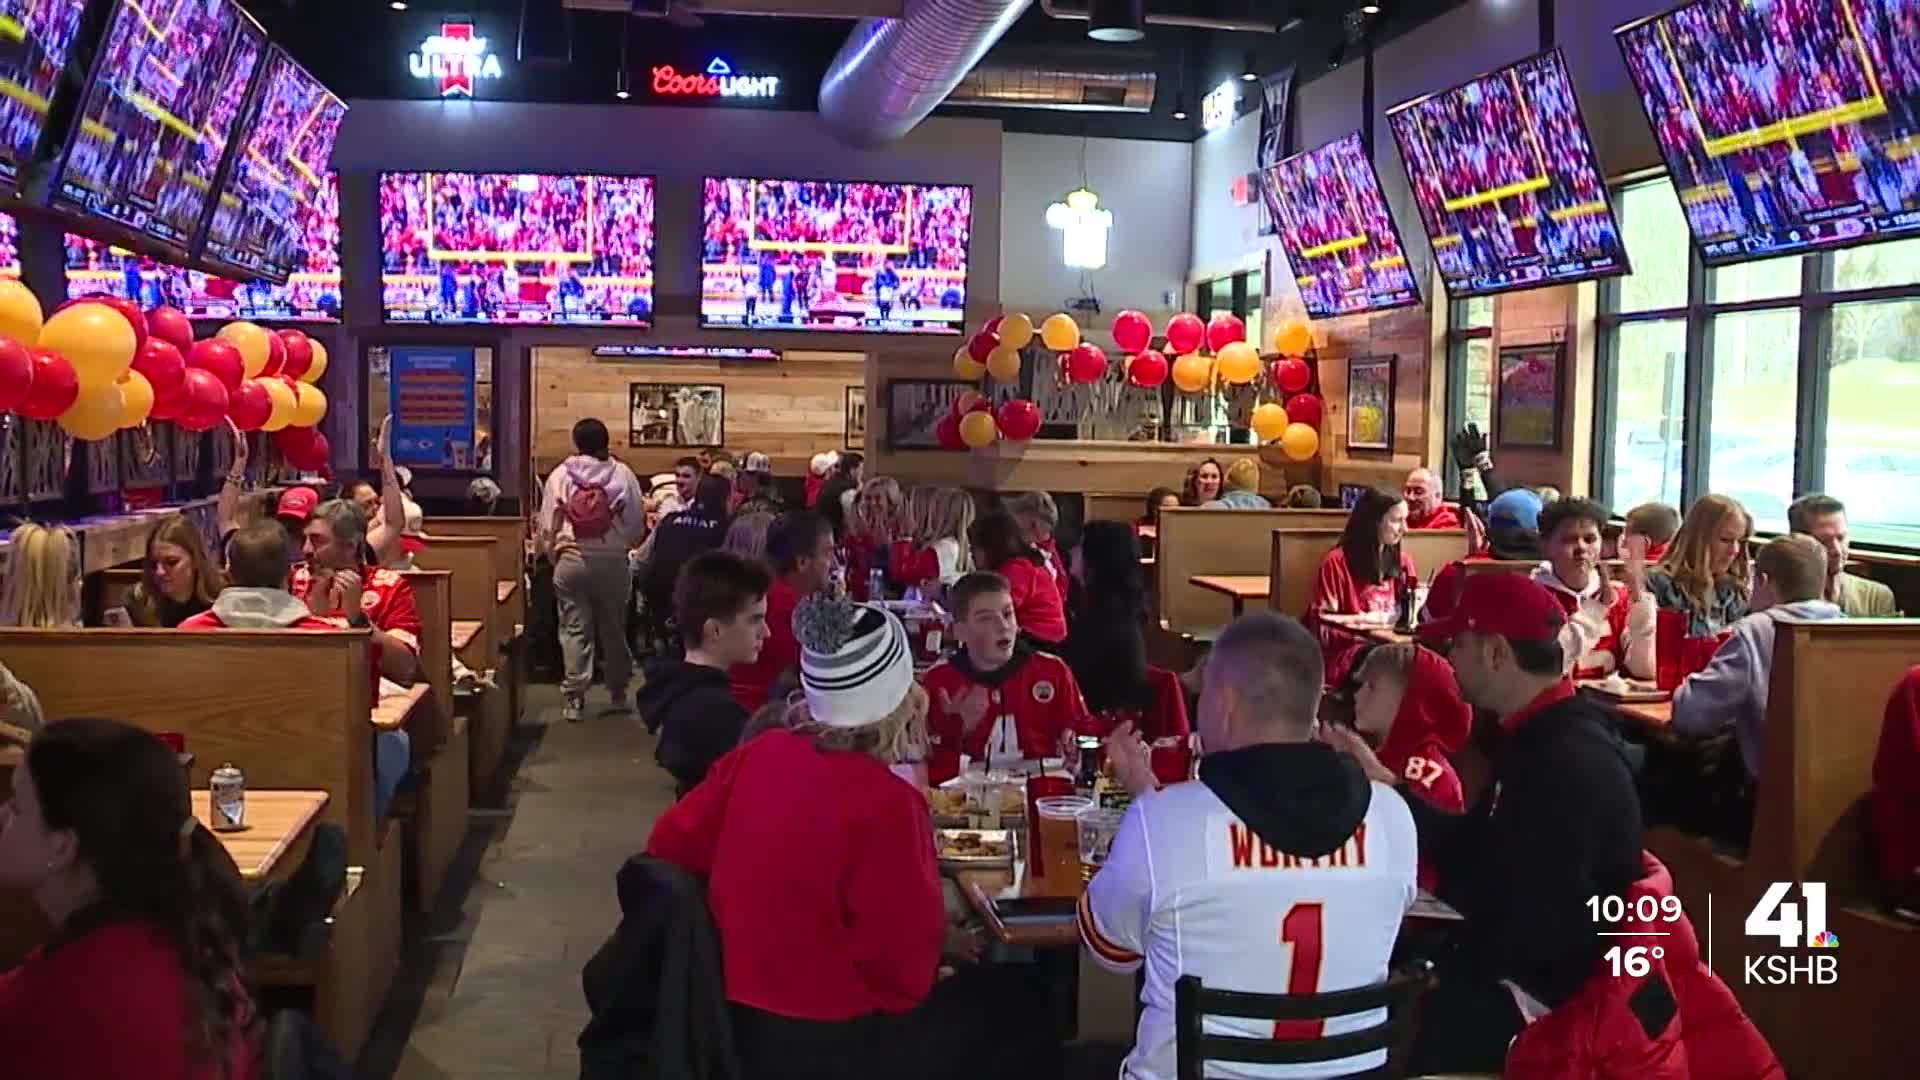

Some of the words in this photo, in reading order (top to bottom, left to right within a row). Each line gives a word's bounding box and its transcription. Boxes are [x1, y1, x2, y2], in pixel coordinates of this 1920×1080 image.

[409, 53, 502, 78] ULTRA
[652, 64, 720, 95] Coors
[720, 75, 778, 96] LIGHT
[1404, 756, 1443, 790] 87
[1272, 902, 1325, 1040] 1
